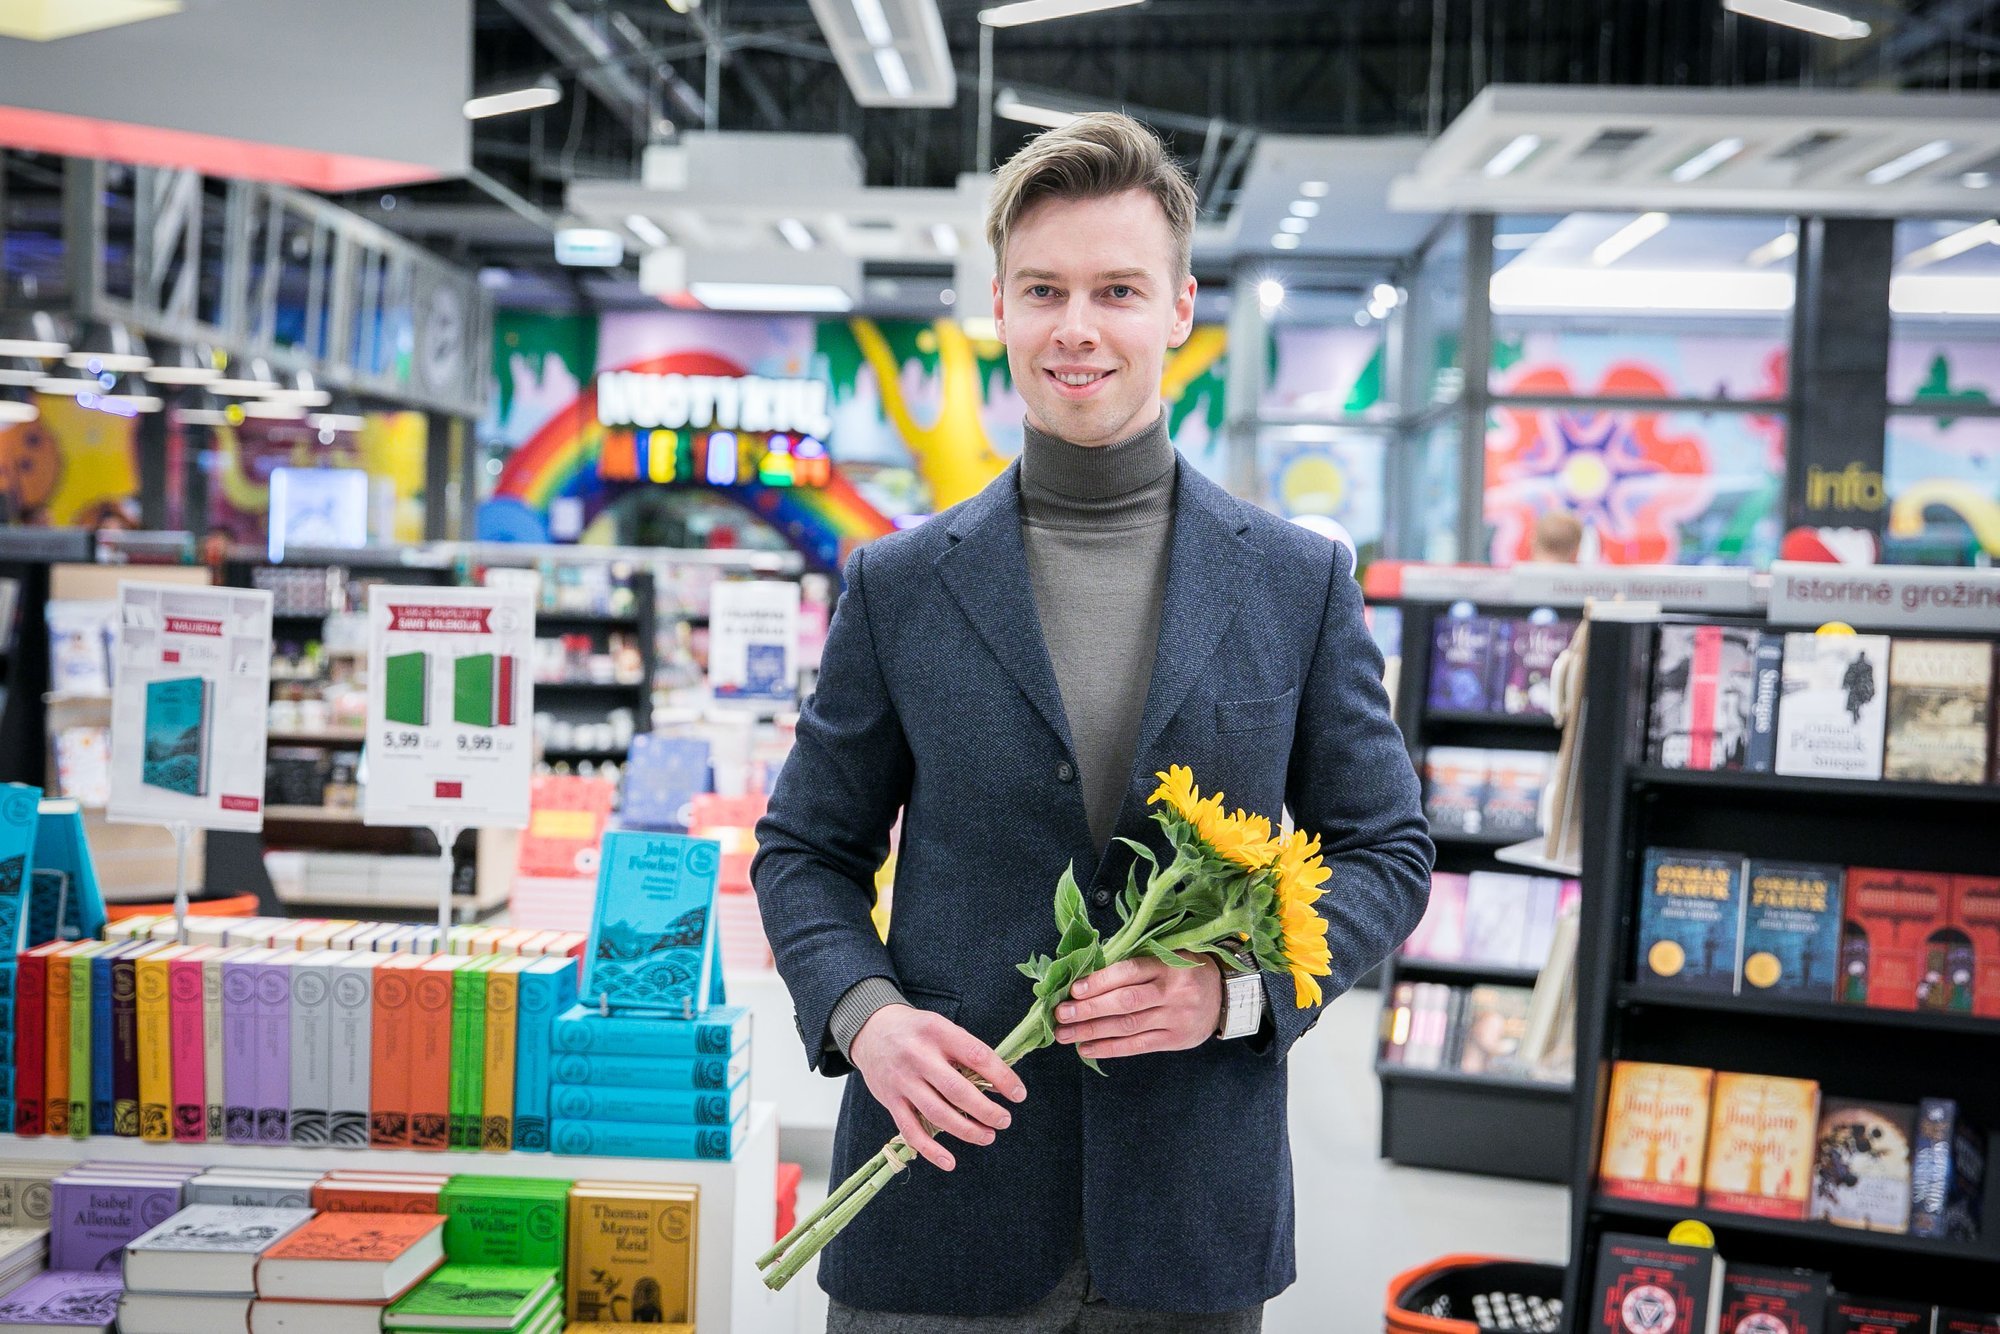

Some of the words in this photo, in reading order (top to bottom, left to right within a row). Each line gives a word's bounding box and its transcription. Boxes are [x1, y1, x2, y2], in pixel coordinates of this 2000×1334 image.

[1807, 462, 1885, 512] info
[1787, 577, 1893, 604] Istorinė
[1753, 668, 1780, 734] Sniegas
[383, 732, 420, 749] 5,99
[457, 734, 493, 751] 9,99
[1791, 732, 1865, 751] Pamuk
[643, 841, 679, 858] John
[90, 1193, 133, 1210] Isabel
[74, 1210, 131, 1228] Allende
[592, 1203, 648, 1220] Thomas
[600, 1221, 648, 1238] Mayne
[616, 1237, 648, 1251] Reid
